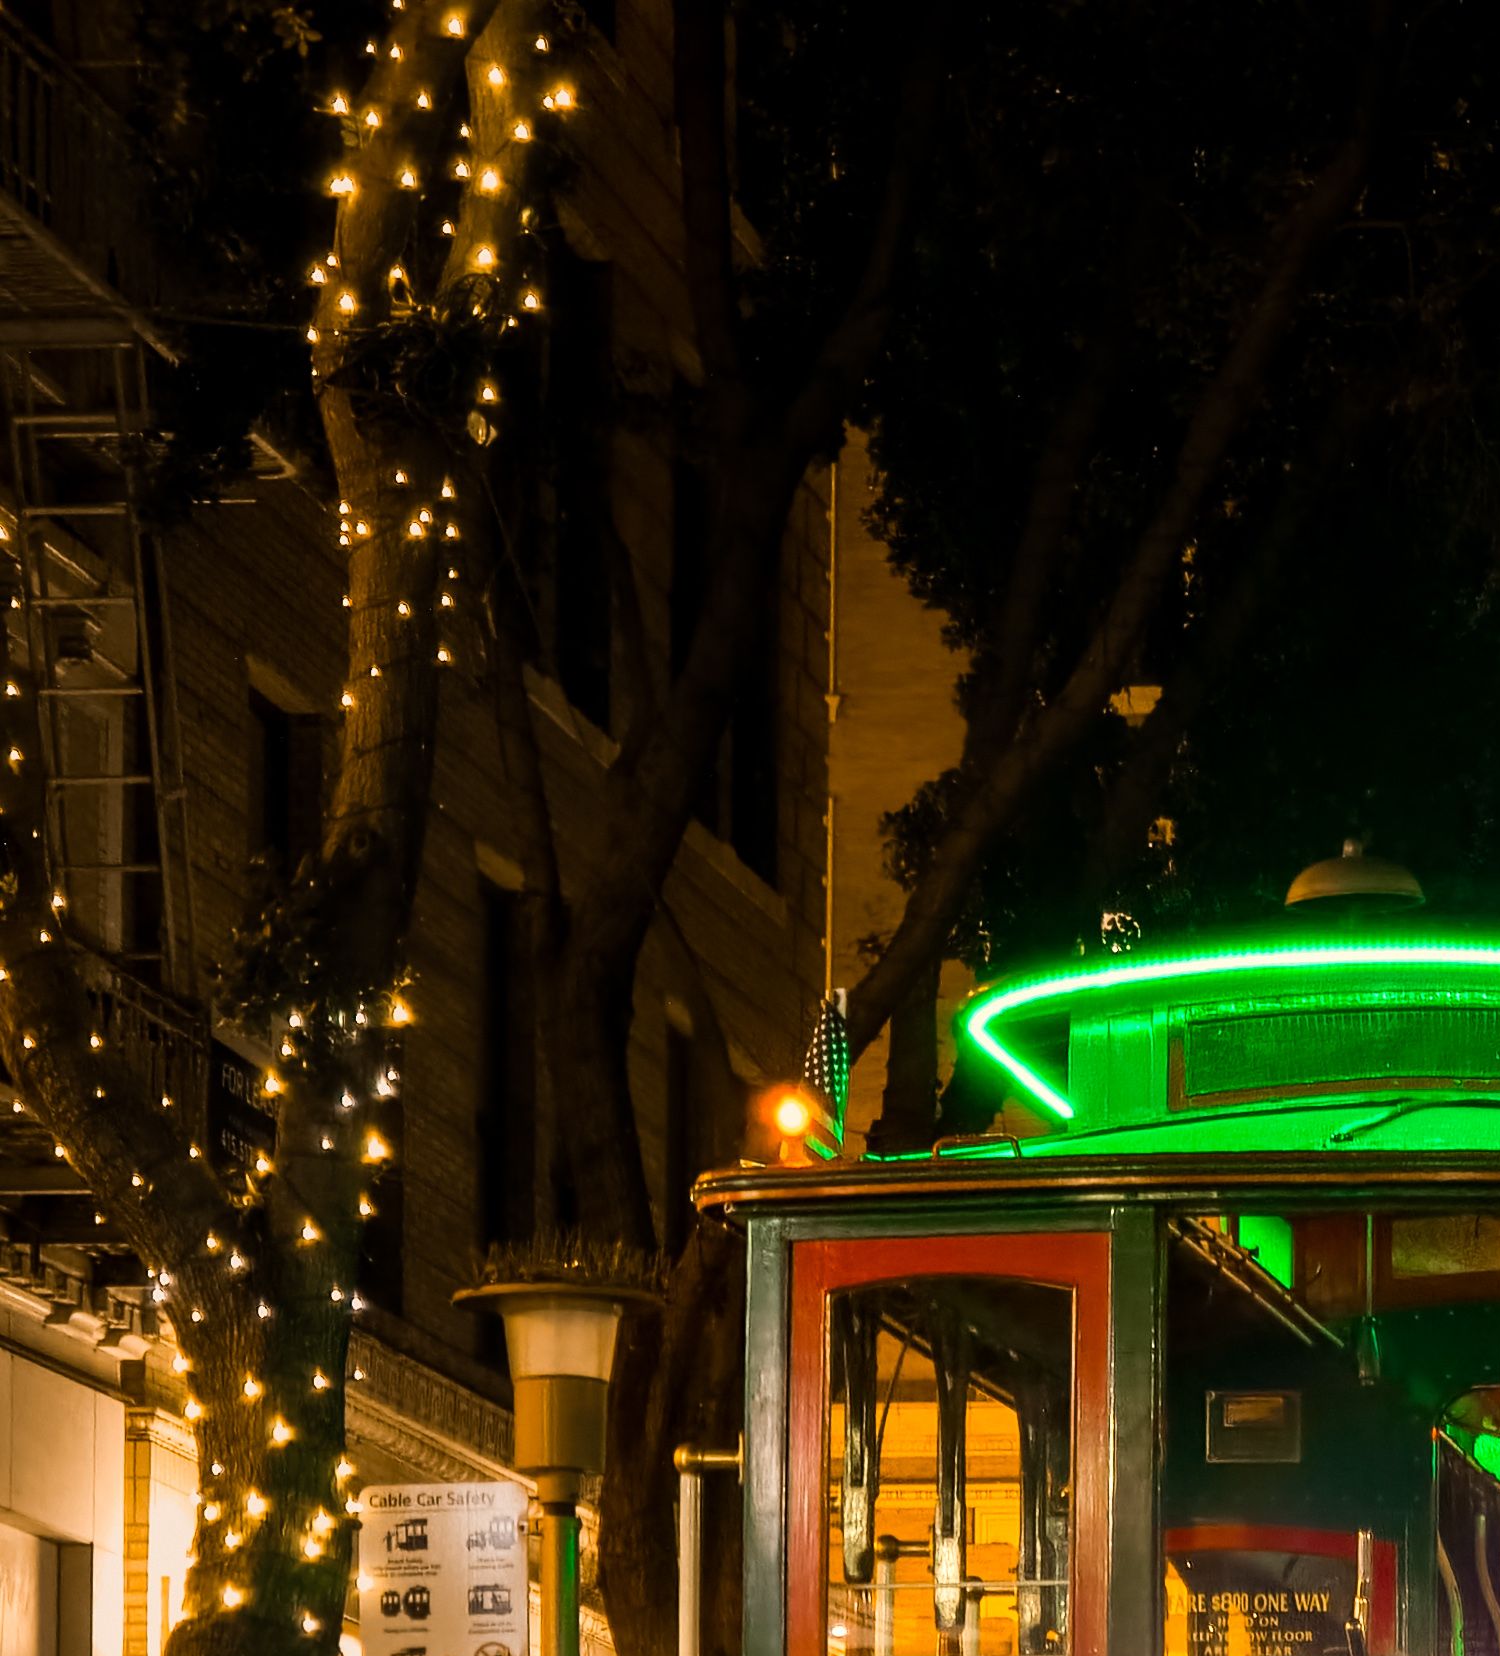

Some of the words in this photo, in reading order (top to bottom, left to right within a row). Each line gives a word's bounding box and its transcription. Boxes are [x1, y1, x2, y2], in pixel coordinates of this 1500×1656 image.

[369, 1493, 412, 1508] Cable
[417, 1492, 442, 1507] Car
[447, 1491, 495, 1506] Safety
[1254, 1592, 1289, 1613] ONE
[1294, 1592, 1330, 1613] WAY
[1217, 1616, 1254, 1628] HD
[1259, 1616, 1279, 1628] ON
[1272, 1630, 1313, 1642] FLOOR
